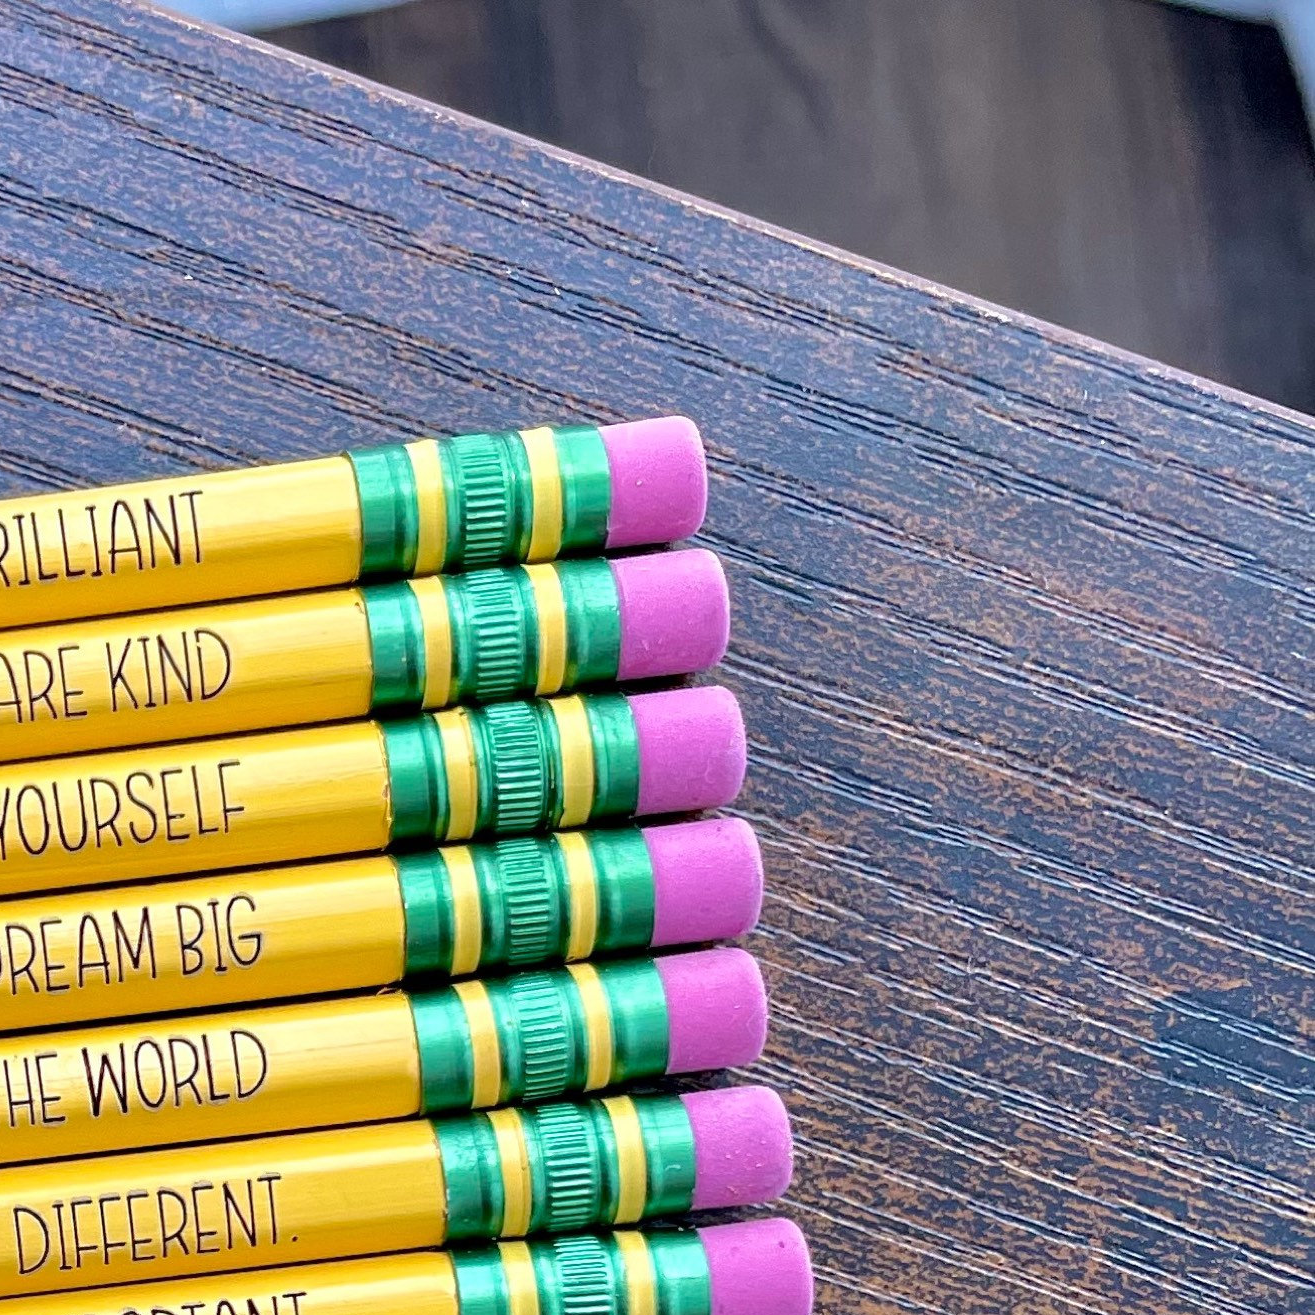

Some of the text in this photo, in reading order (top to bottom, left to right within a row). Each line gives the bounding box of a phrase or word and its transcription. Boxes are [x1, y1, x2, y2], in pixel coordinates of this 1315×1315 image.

[105, 629, 232, 713] KIND
[175, 895, 263, 977] BIG
[81, 1030, 268, 1119] WORLD
[12, 1175, 302, 1276] DIFFERENT.
